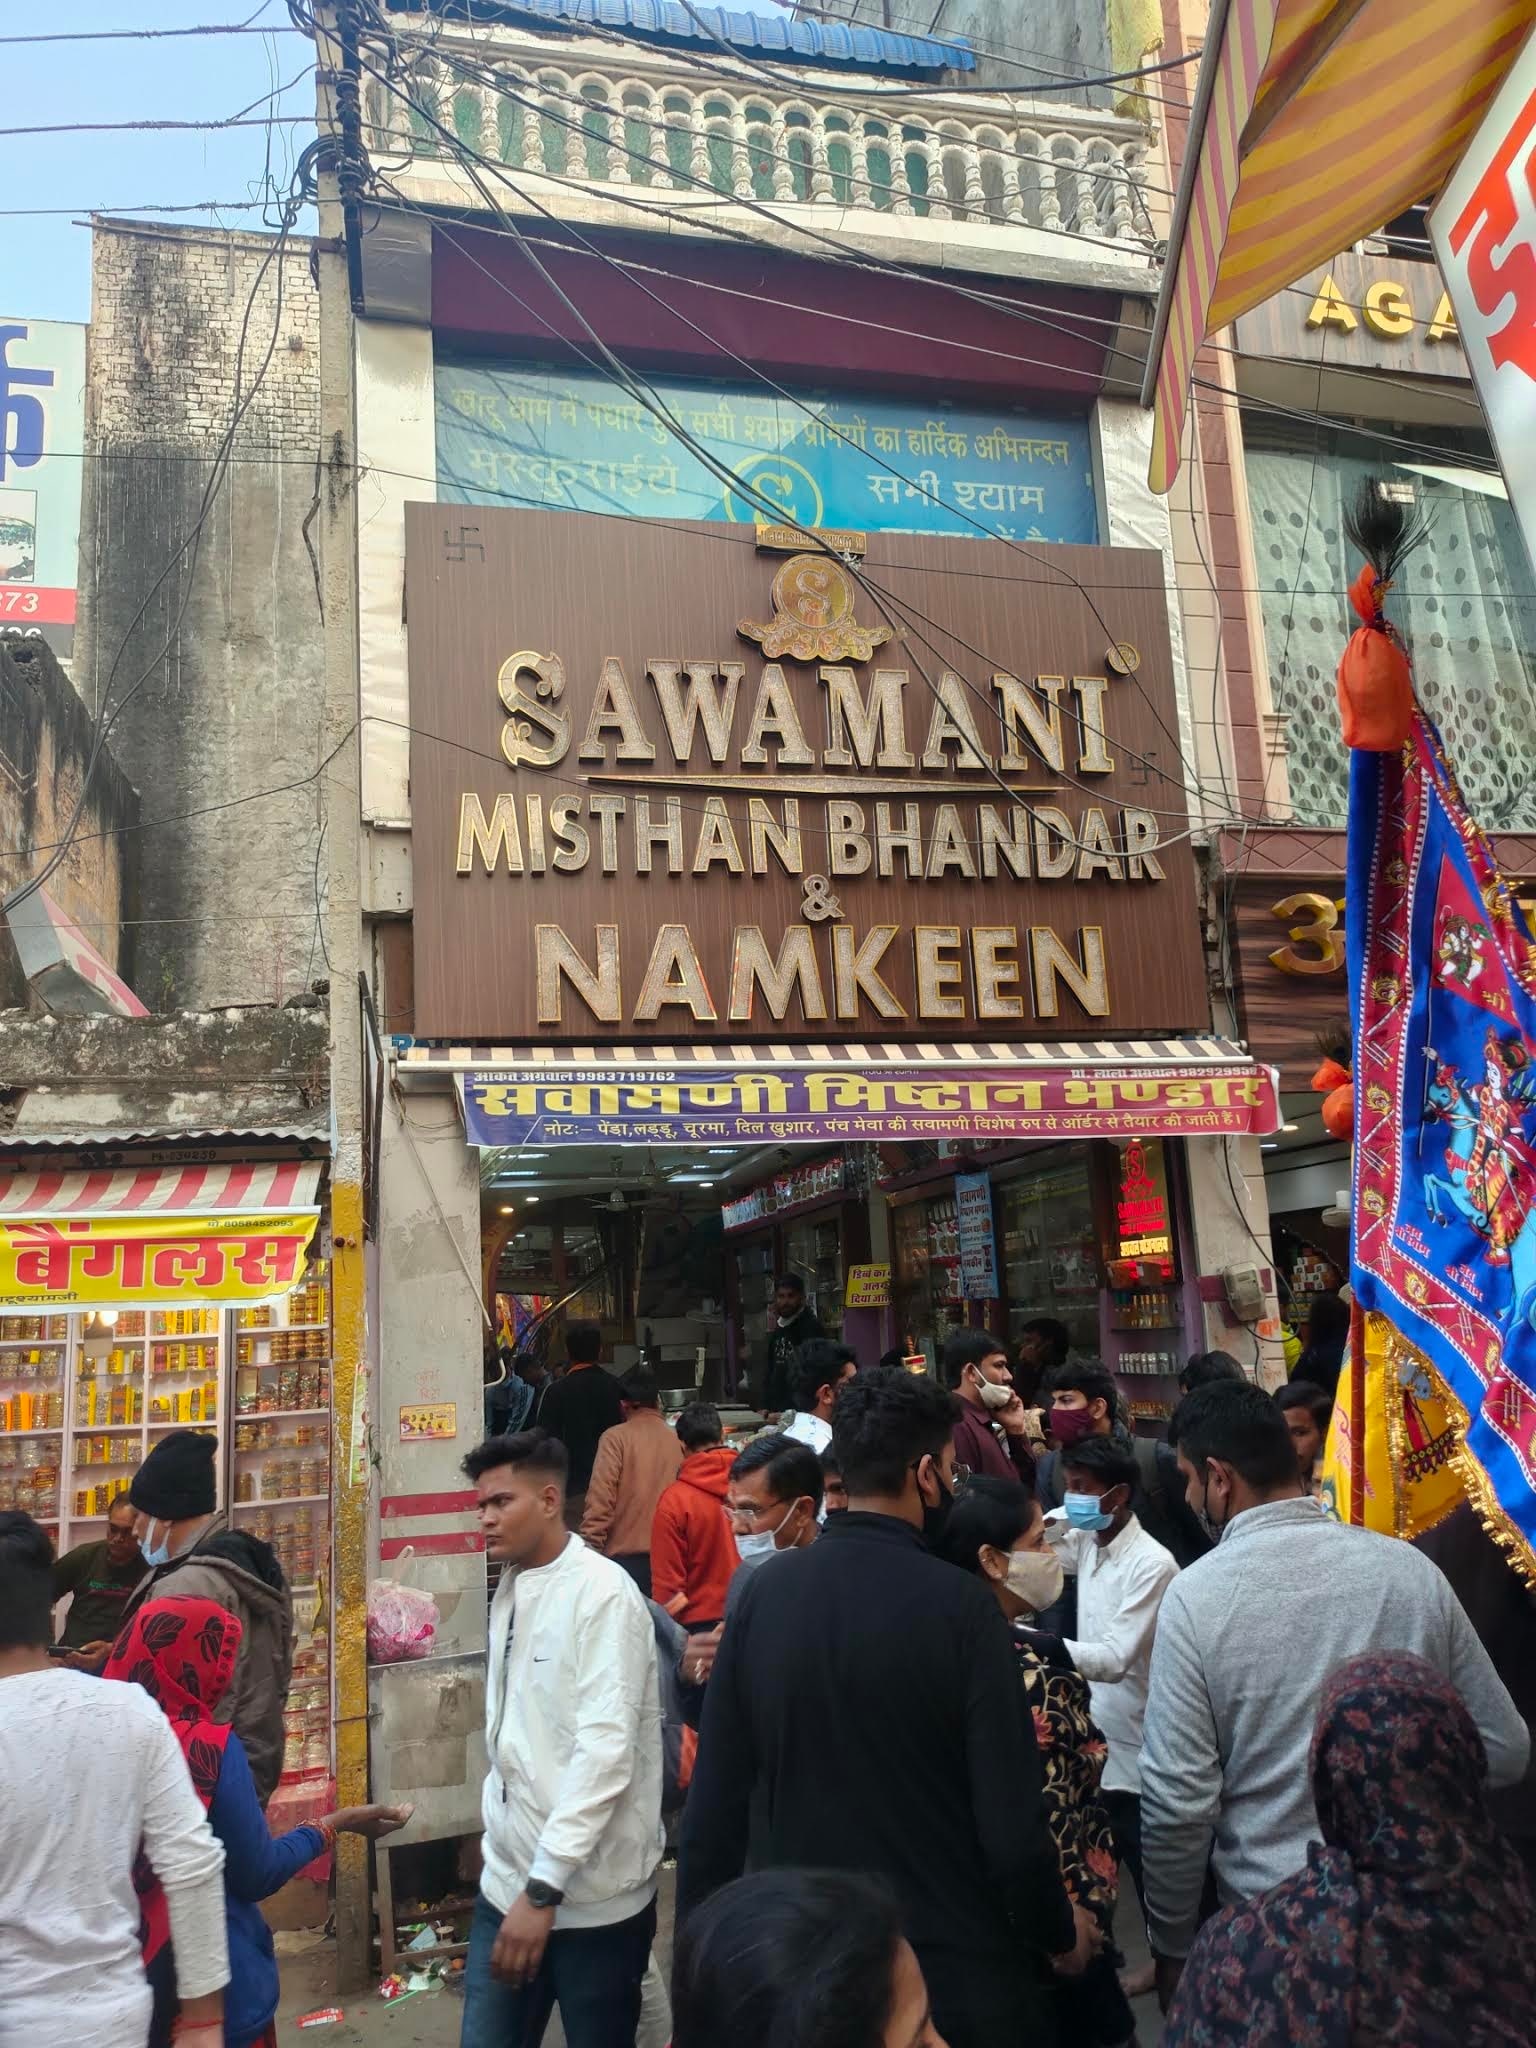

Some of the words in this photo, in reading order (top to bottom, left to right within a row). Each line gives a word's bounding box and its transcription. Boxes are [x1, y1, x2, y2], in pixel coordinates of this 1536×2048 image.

[689, 401, 737, 440] सभी
[743, 414, 797, 445] श्याम
[871, 426, 900, 453] का
[904, 420, 968, 460] हार्दिक
[973, 426, 1070, 466] अभिनन्दन
[953, 479, 1045, 515] श्याम
[497, 648, 1115, 773] SAWAMANI
[456, 792, 803, 876] MISTHAN
[826, 799, 1168, 882] BHANDAR
[800, 874, 845, 922] &
[534, 922, 1111, 1025] NAMKEEN
[473, 1072, 794, 1115] सवामणी
[803, 1072, 1048, 1112] मिष्टान
[1063, 1077, 1268, 1109] भण्डार
[683, 1121, 730, 1138] चूरमा,
[735, 1118, 764, 1134] दिल
[824, 1118, 849, 1132] पंच
[854, 1116, 883, 1132] मेवा
[887, 1115, 907, 1131] की
[911, 1115, 971, 1131] सवामणी
[974, 1114, 1015, 1130] विशेष
[1044, 1115, 1058, 1130] से
[1062, 1113, 1102, 1129] ऑर्डर
[1106, 1113, 1119, 1129] से
[1123, 1112, 1160, 1128] तैयार
[1163, 1112, 1182, 1127] की
[1185, 1112, 1220, 1126] जाती
